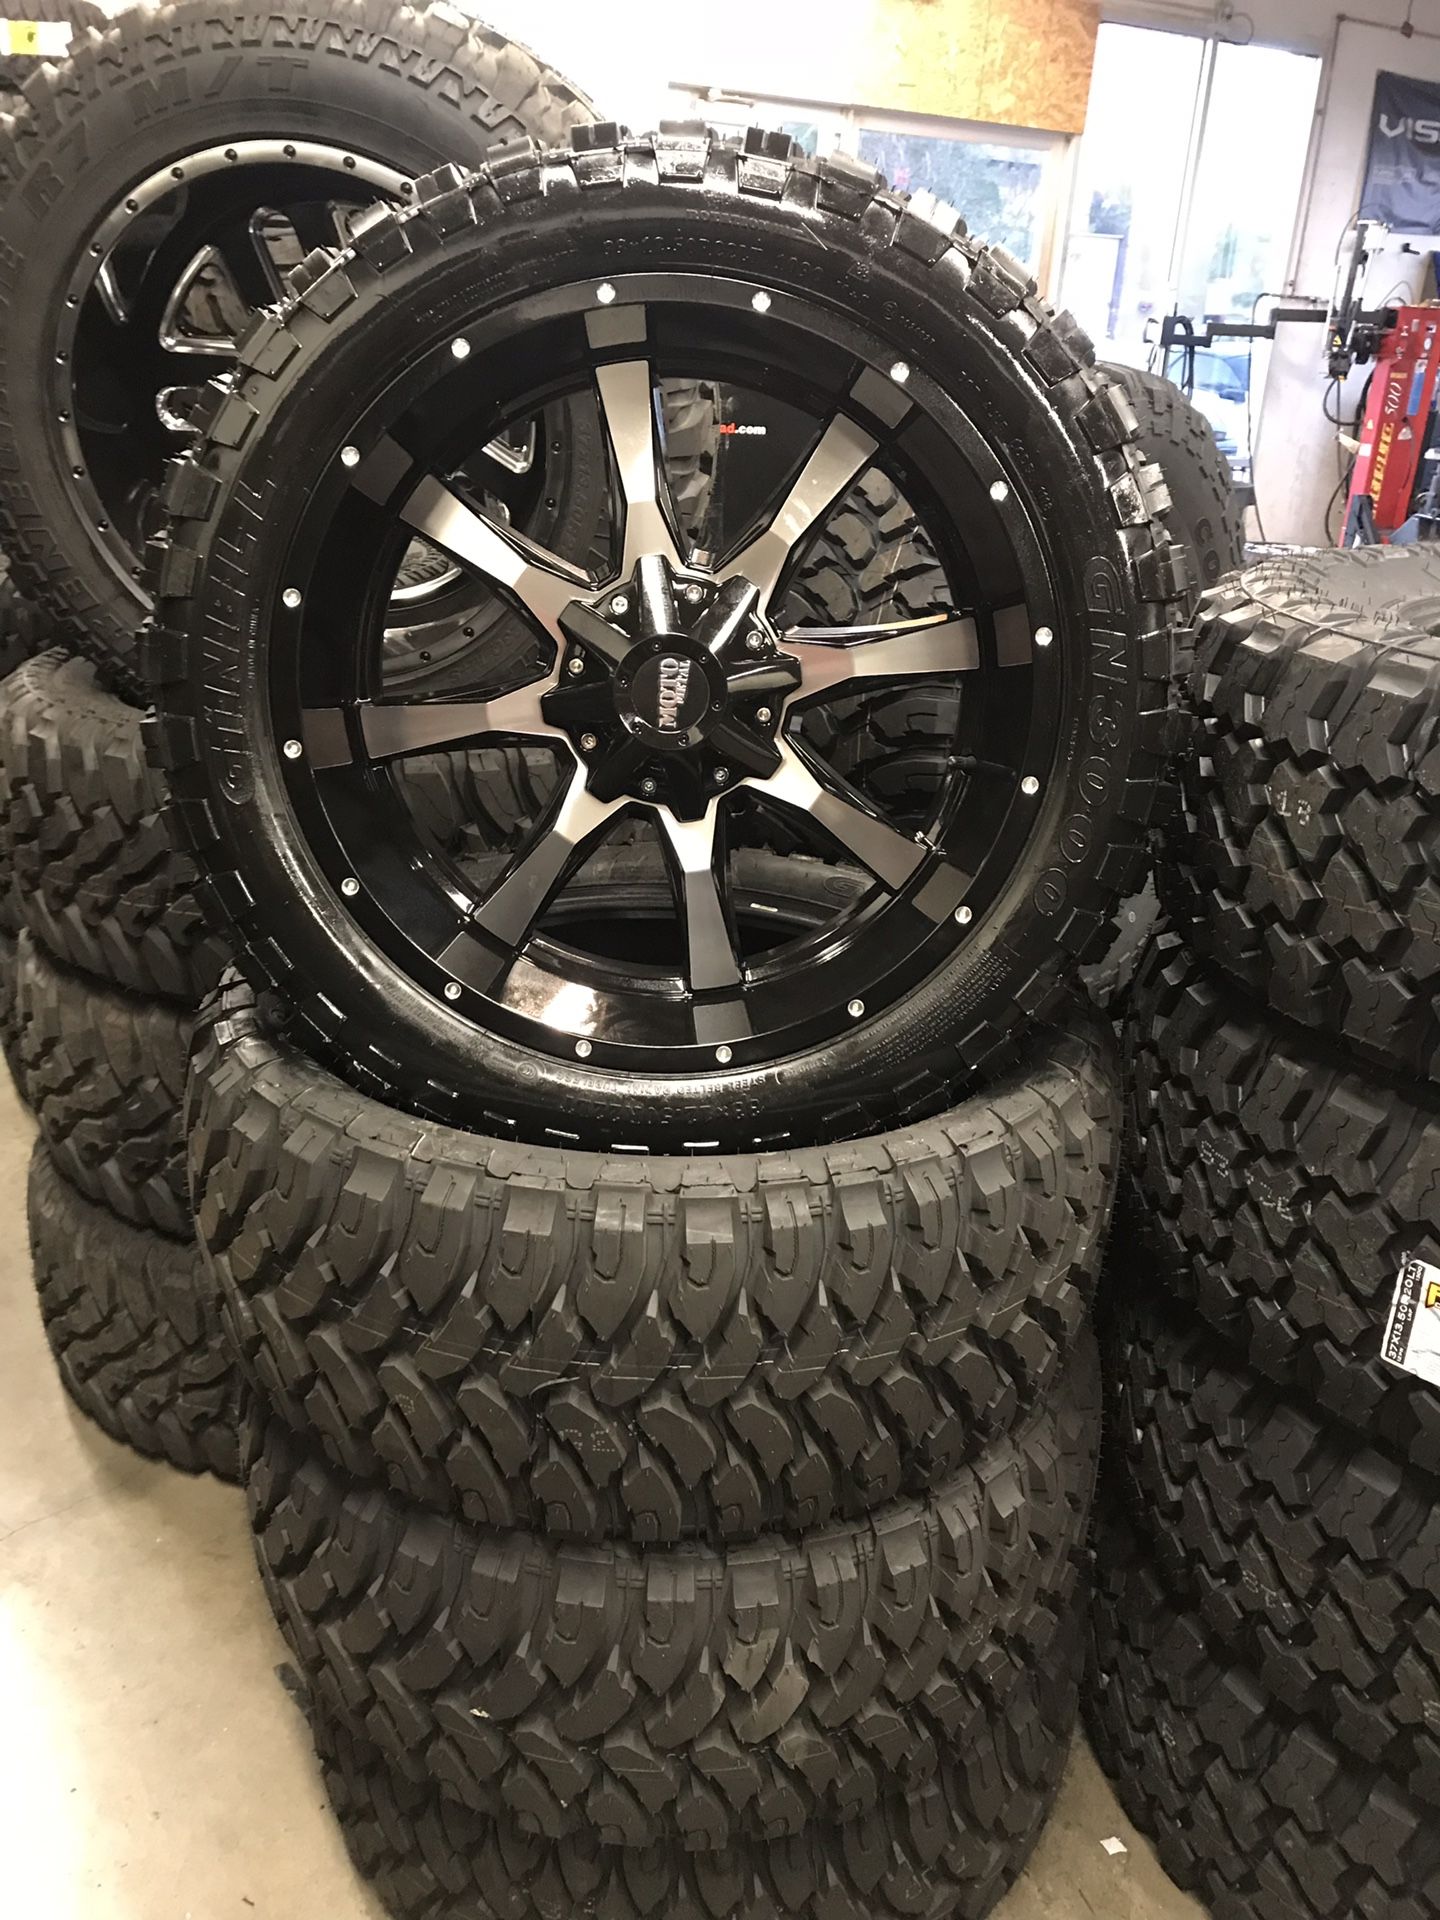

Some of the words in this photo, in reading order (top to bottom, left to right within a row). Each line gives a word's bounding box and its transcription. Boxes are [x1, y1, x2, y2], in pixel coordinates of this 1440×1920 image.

[123, 55, 310, 126] M/T
[659, 657, 679, 728] MOTO
[675, 659, 691, 704] METAL
[1033, 555, 1128, 917] GN3000
[1387, 1264, 1418, 1360] 37X13.50R20LT
